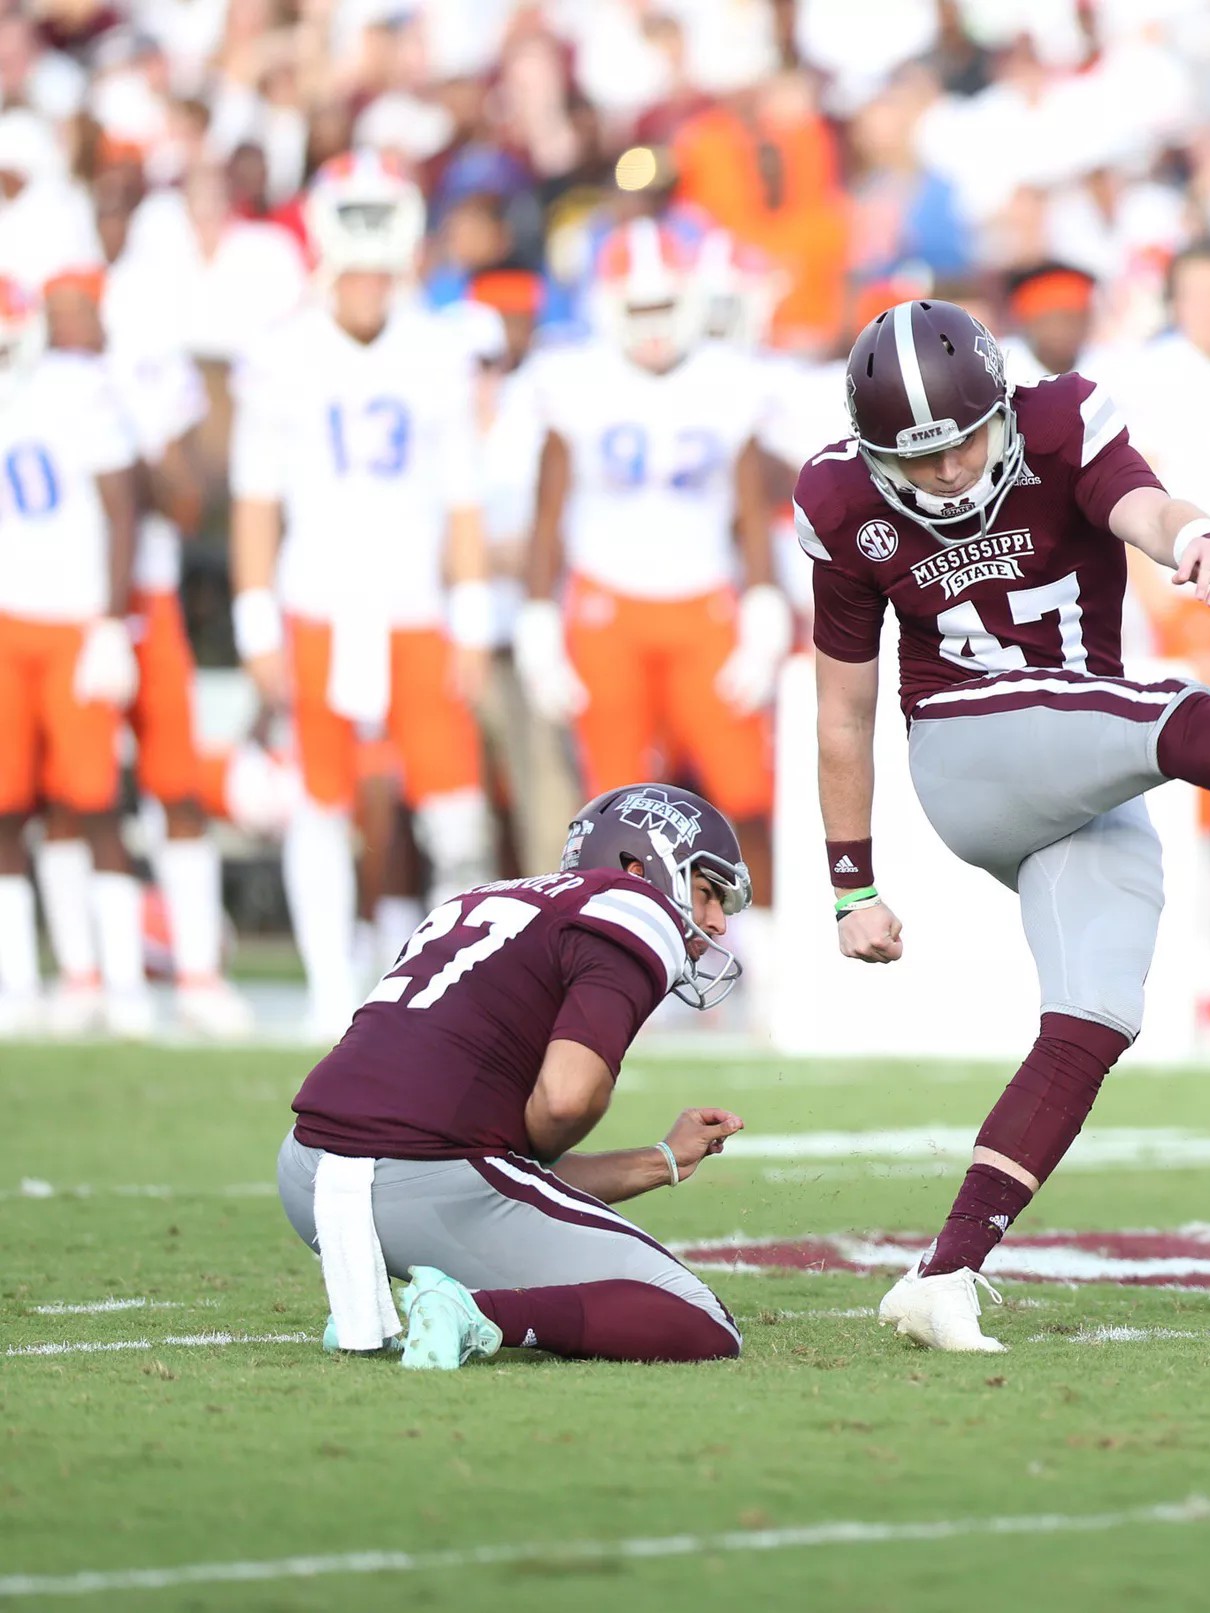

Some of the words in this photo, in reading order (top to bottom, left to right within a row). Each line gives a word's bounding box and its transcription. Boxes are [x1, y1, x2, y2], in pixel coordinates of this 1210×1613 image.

[327, 396, 412, 479] 13
[911, 427, 942, 441] STATE
[859, 521, 898, 560] SEC
[911, 532, 1034, 586] MISSISSIPPI
[953, 562, 1009, 589] STATE
[936, 570, 1088, 679] 47
[635, 798, 688, 830] STATE
[362, 895, 542, 1009] 27
